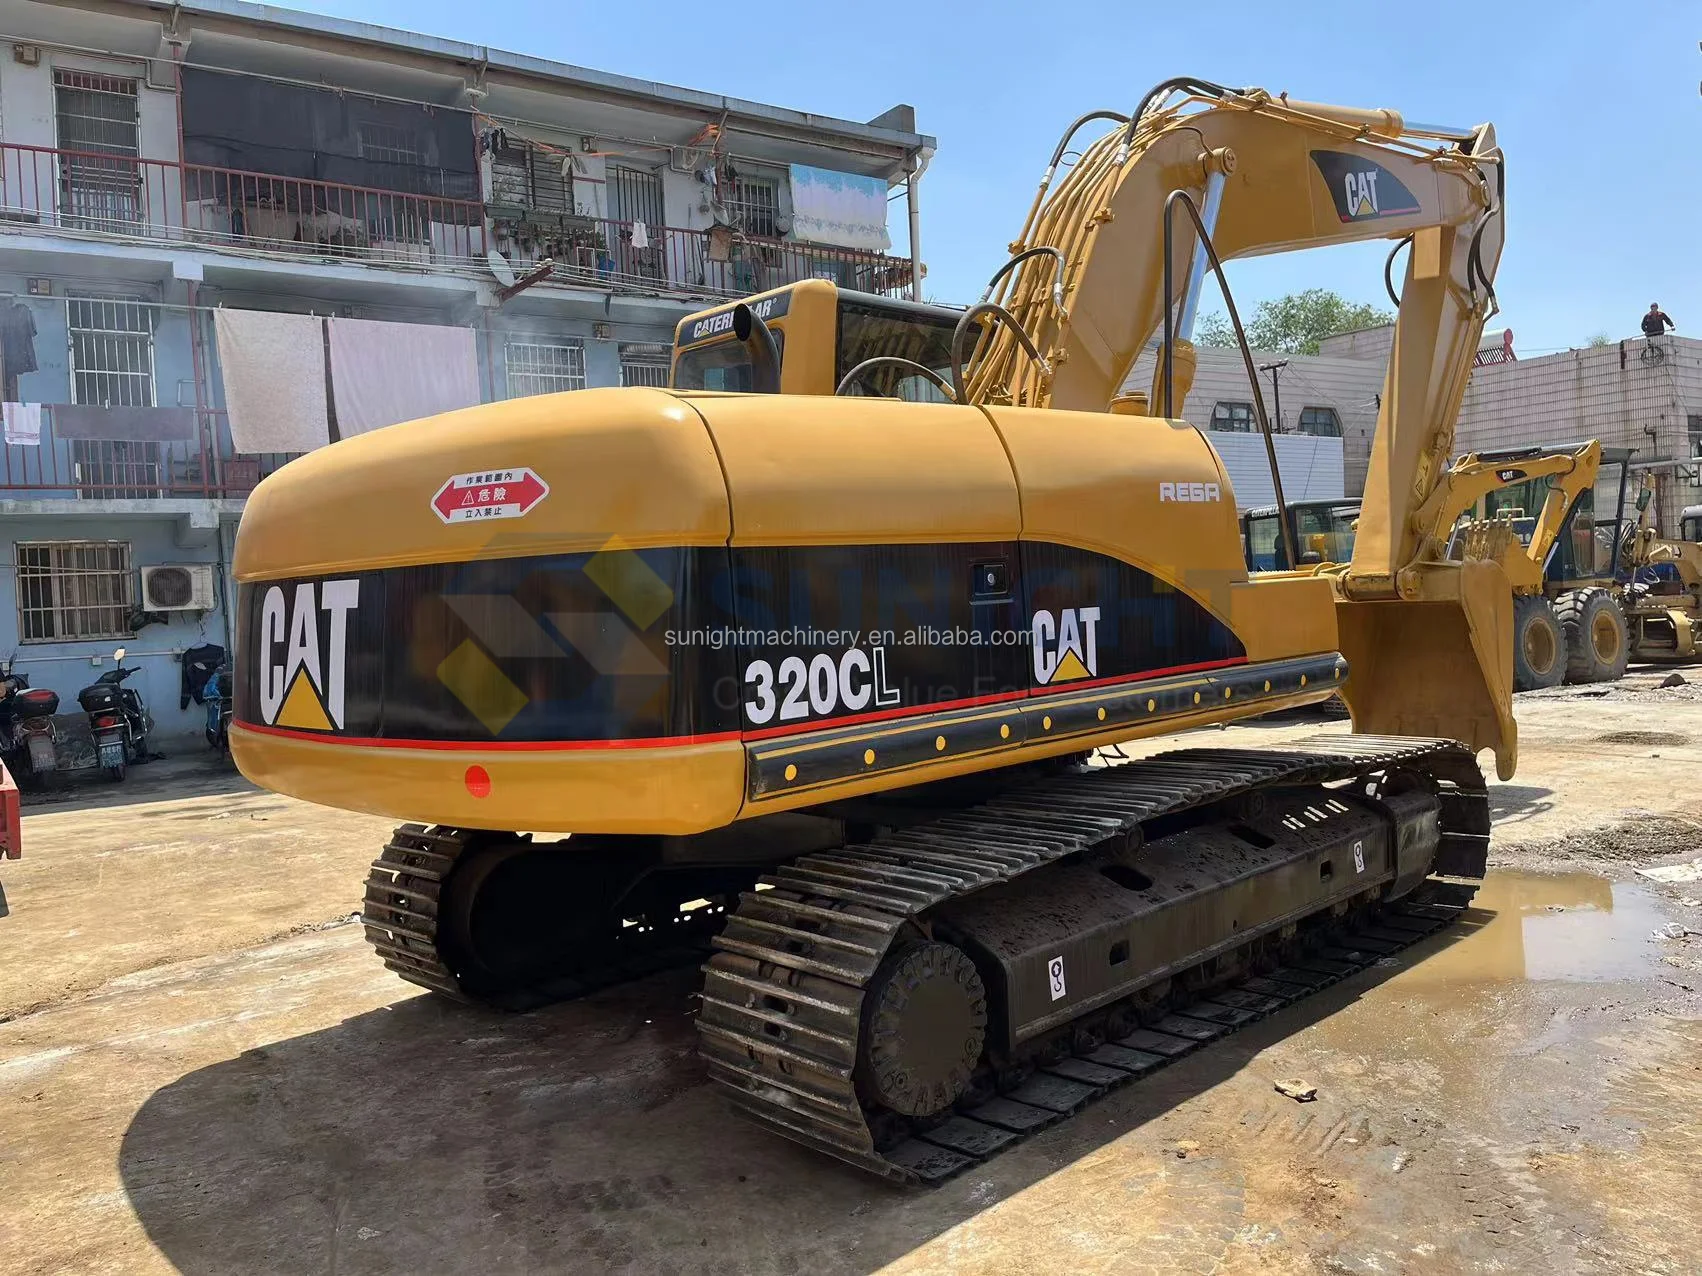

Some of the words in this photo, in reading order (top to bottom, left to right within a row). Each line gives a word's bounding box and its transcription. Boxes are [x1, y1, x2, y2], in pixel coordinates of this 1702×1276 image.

[1345, 170, 1378, 217] CAT
[465, 507, 502, 519] 立入禁止
[1160, 482, 1220, 502] REGA
[259, 578, 360, 730] CAT
[1032, 607, 1099, 684] CAT
